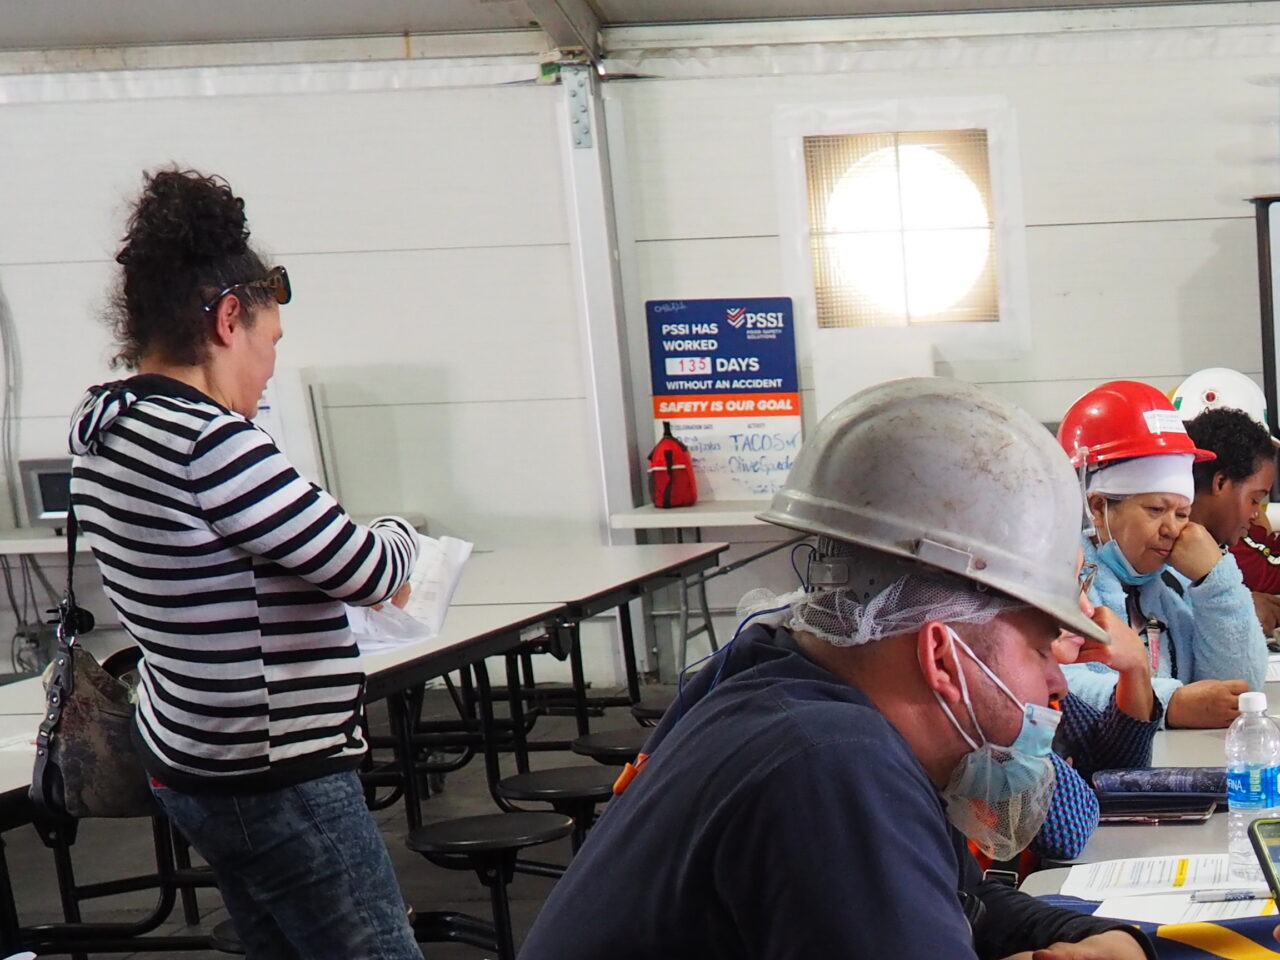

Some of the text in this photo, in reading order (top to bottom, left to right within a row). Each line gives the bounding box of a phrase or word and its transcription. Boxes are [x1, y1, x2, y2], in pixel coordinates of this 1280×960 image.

[746, 313, 784, 328] PSSI
[662, 323, 718, 335] PSSI HAS
[663, 340, 718, 351] WORKED
[678, 357, 760, 372] 135 DAYS
[666, 378, 783, 390] WITHOUT AN ACCIDENT
[659, 399, 793, 413] SAFETY IS OUR GOAL
